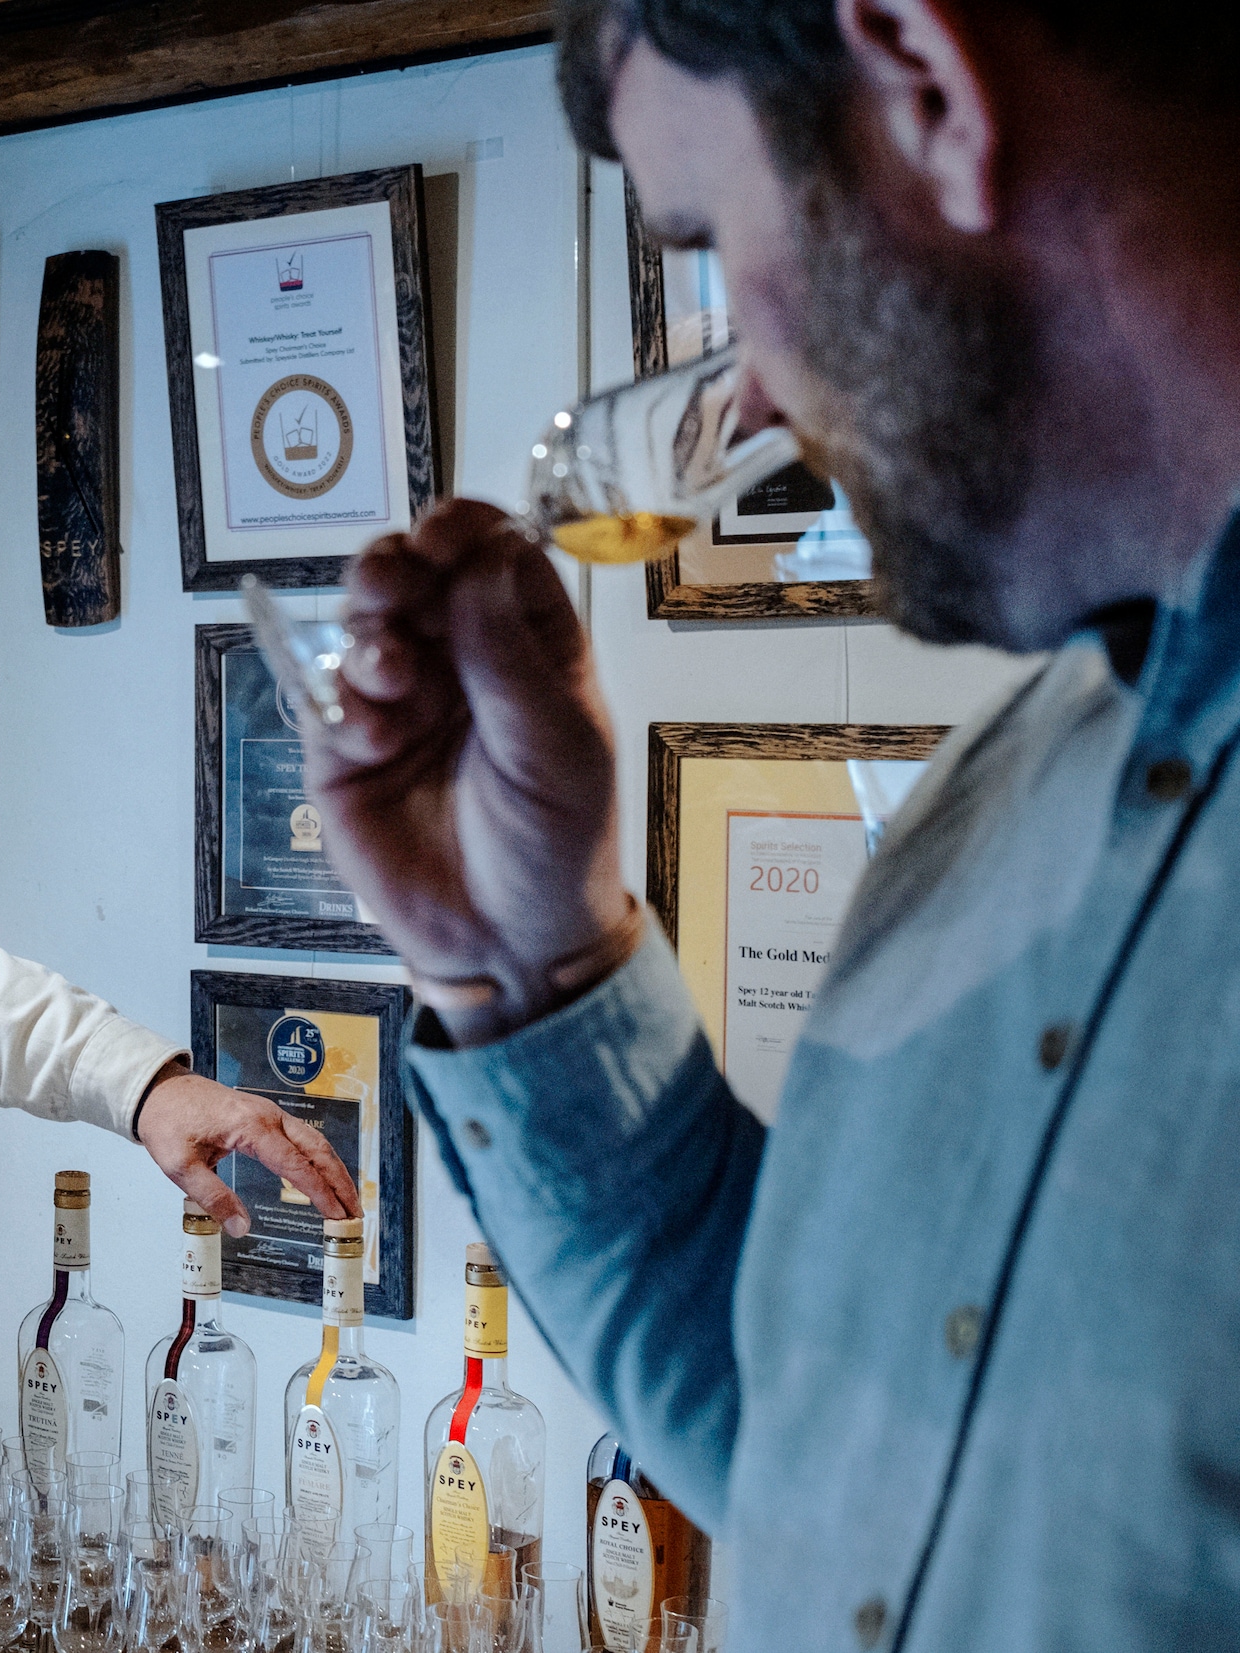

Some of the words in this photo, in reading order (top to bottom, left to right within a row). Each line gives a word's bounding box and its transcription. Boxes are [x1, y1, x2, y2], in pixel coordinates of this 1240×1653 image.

[317, 327, 343, 336] Yourself
[269, 378, 300, 398] CHOICE
[302, 378, 330, 397] SPIRITS
[329, 395, 350, 434] AWARDS
[273, 455, 290, 473] GOLD
[291, 468, 316, 477] AWARD
[240, 510, 376, 525] www.peopleschoicespiritsawards.com
[40, 539, 99, 558] SPEY
[275, 763, 296, 773] SPEY
[780, 842, 823, 853] Selection
[749, 865, 820, 895] 2020
[319, 901, 354, 913] DRINKS
[738, 945, 764, 960] The
[766, 947, 798, 962] Gold
[801, 950, 831, 964] Med
[738, 986, 757, 997] Spey
[759, 988, 770, 996] 12
[769, 990, 788, 998] year
[790, 990, 803, 998] old
[737, 998, 758, 1007] Malt
[758, 1000, 786, 1010] Scotch
[277, 1050, 306, 1059] SPIRITS
[288, 1065, 306, 1075] 2020
[28, 1379, 57, 1393] SPEY
[156, 1410, 188, 1425] SPEY
[297, 1438, 331, 1454] SPEY
[439, 1474, 476, 1492] SPEY
[601, 1516, 641, 1534] SPEY
[599, 1539, 619, 1549] ROYAL
[618, 1544, 645, 1554] CHOICE
